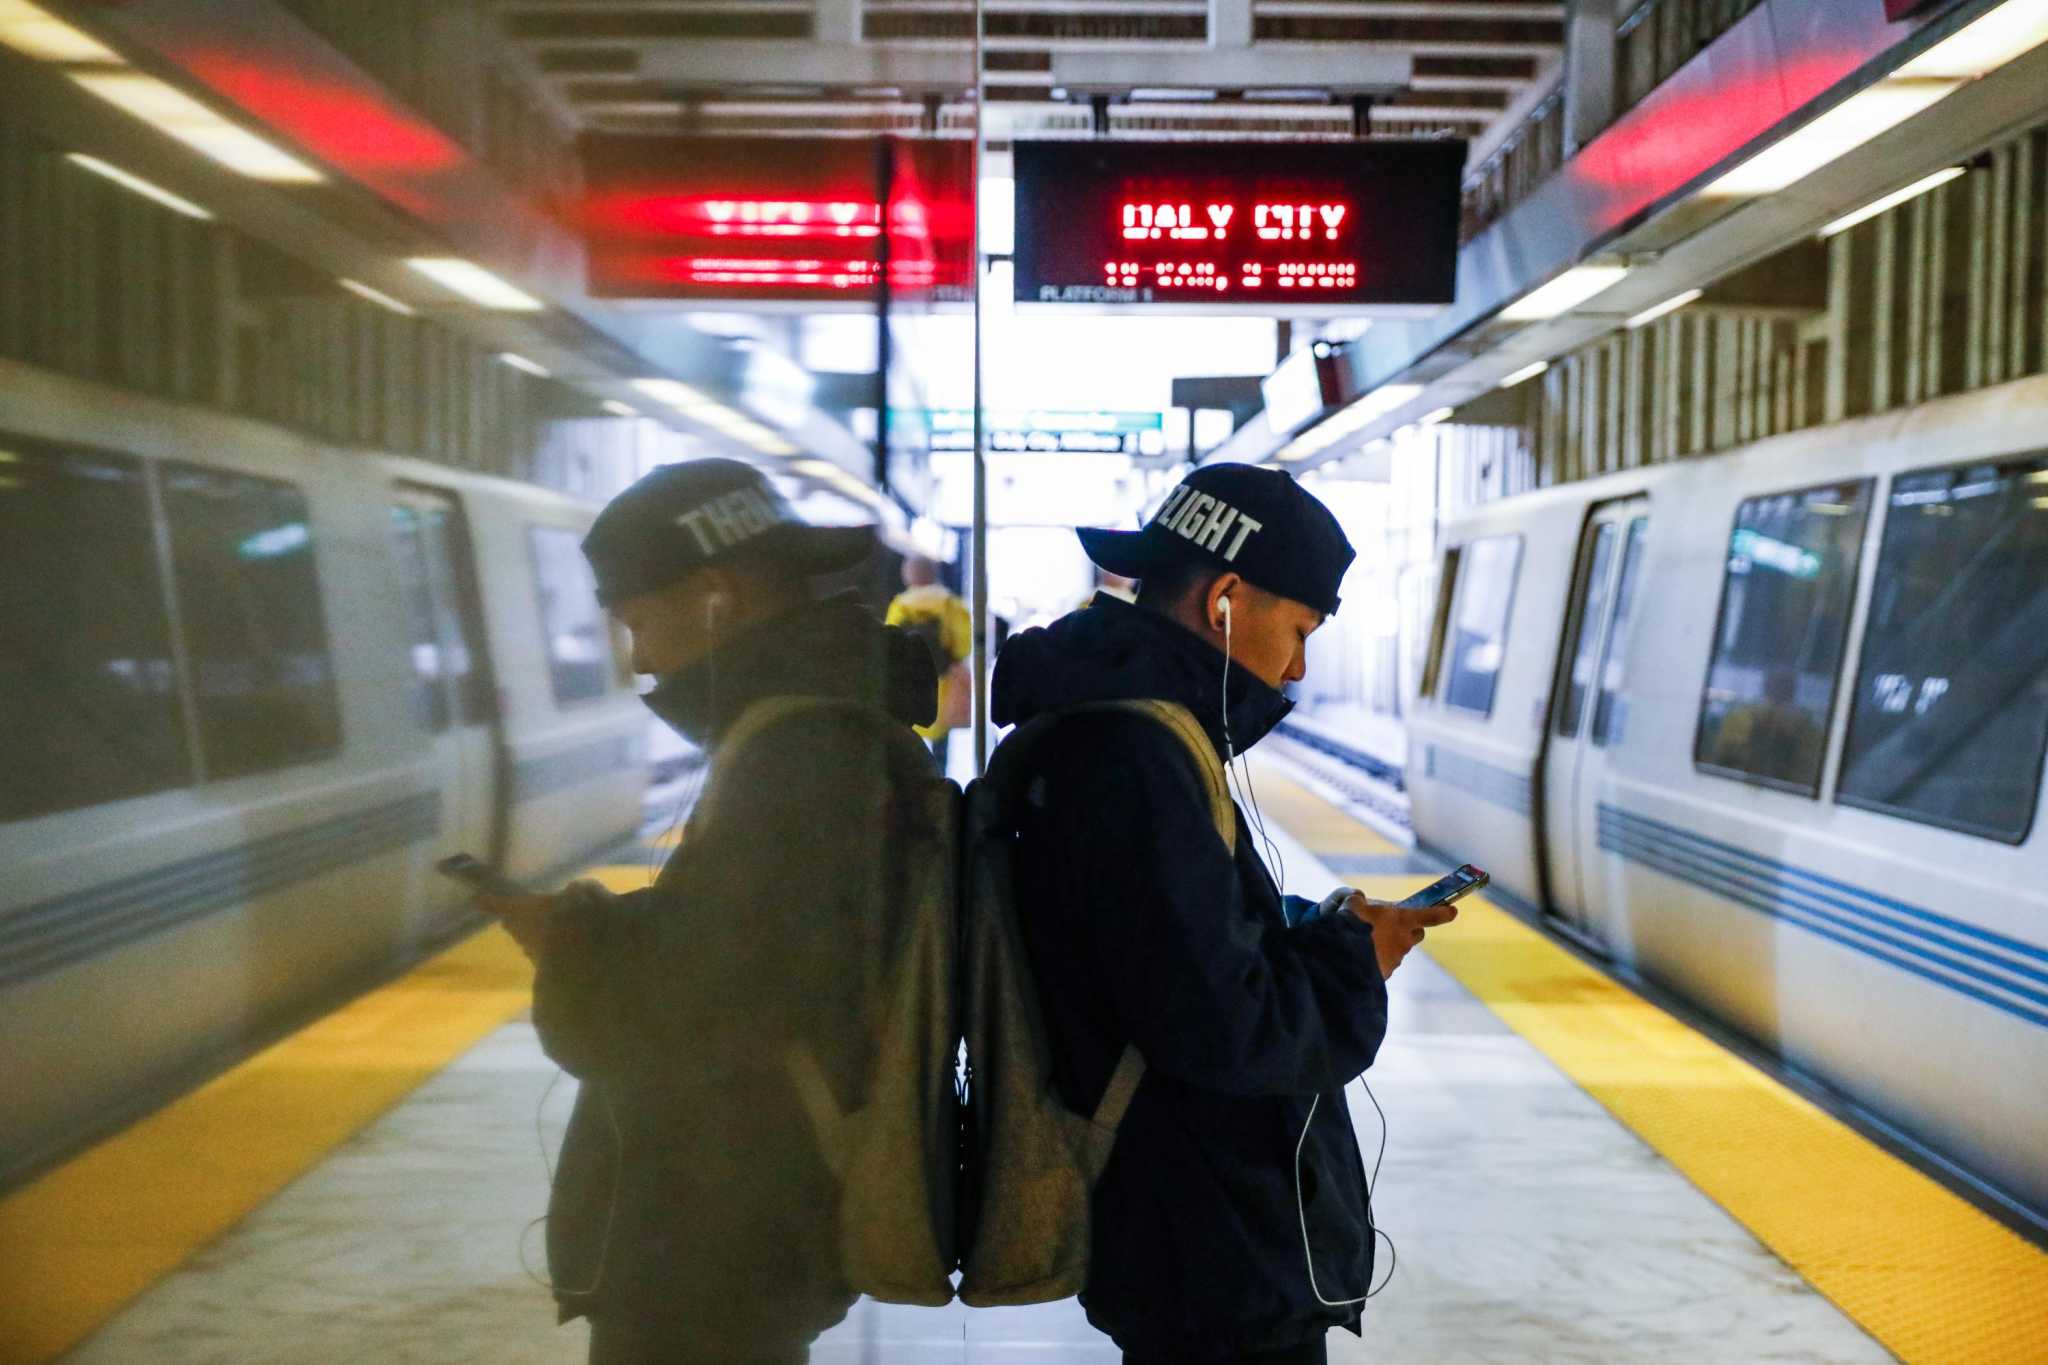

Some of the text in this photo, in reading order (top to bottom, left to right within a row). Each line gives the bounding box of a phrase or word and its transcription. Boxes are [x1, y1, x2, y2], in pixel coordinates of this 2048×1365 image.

[1122, 203, 1346, 240] DALY CITY
[1039, 285, 1138, 301] PLATFORM
